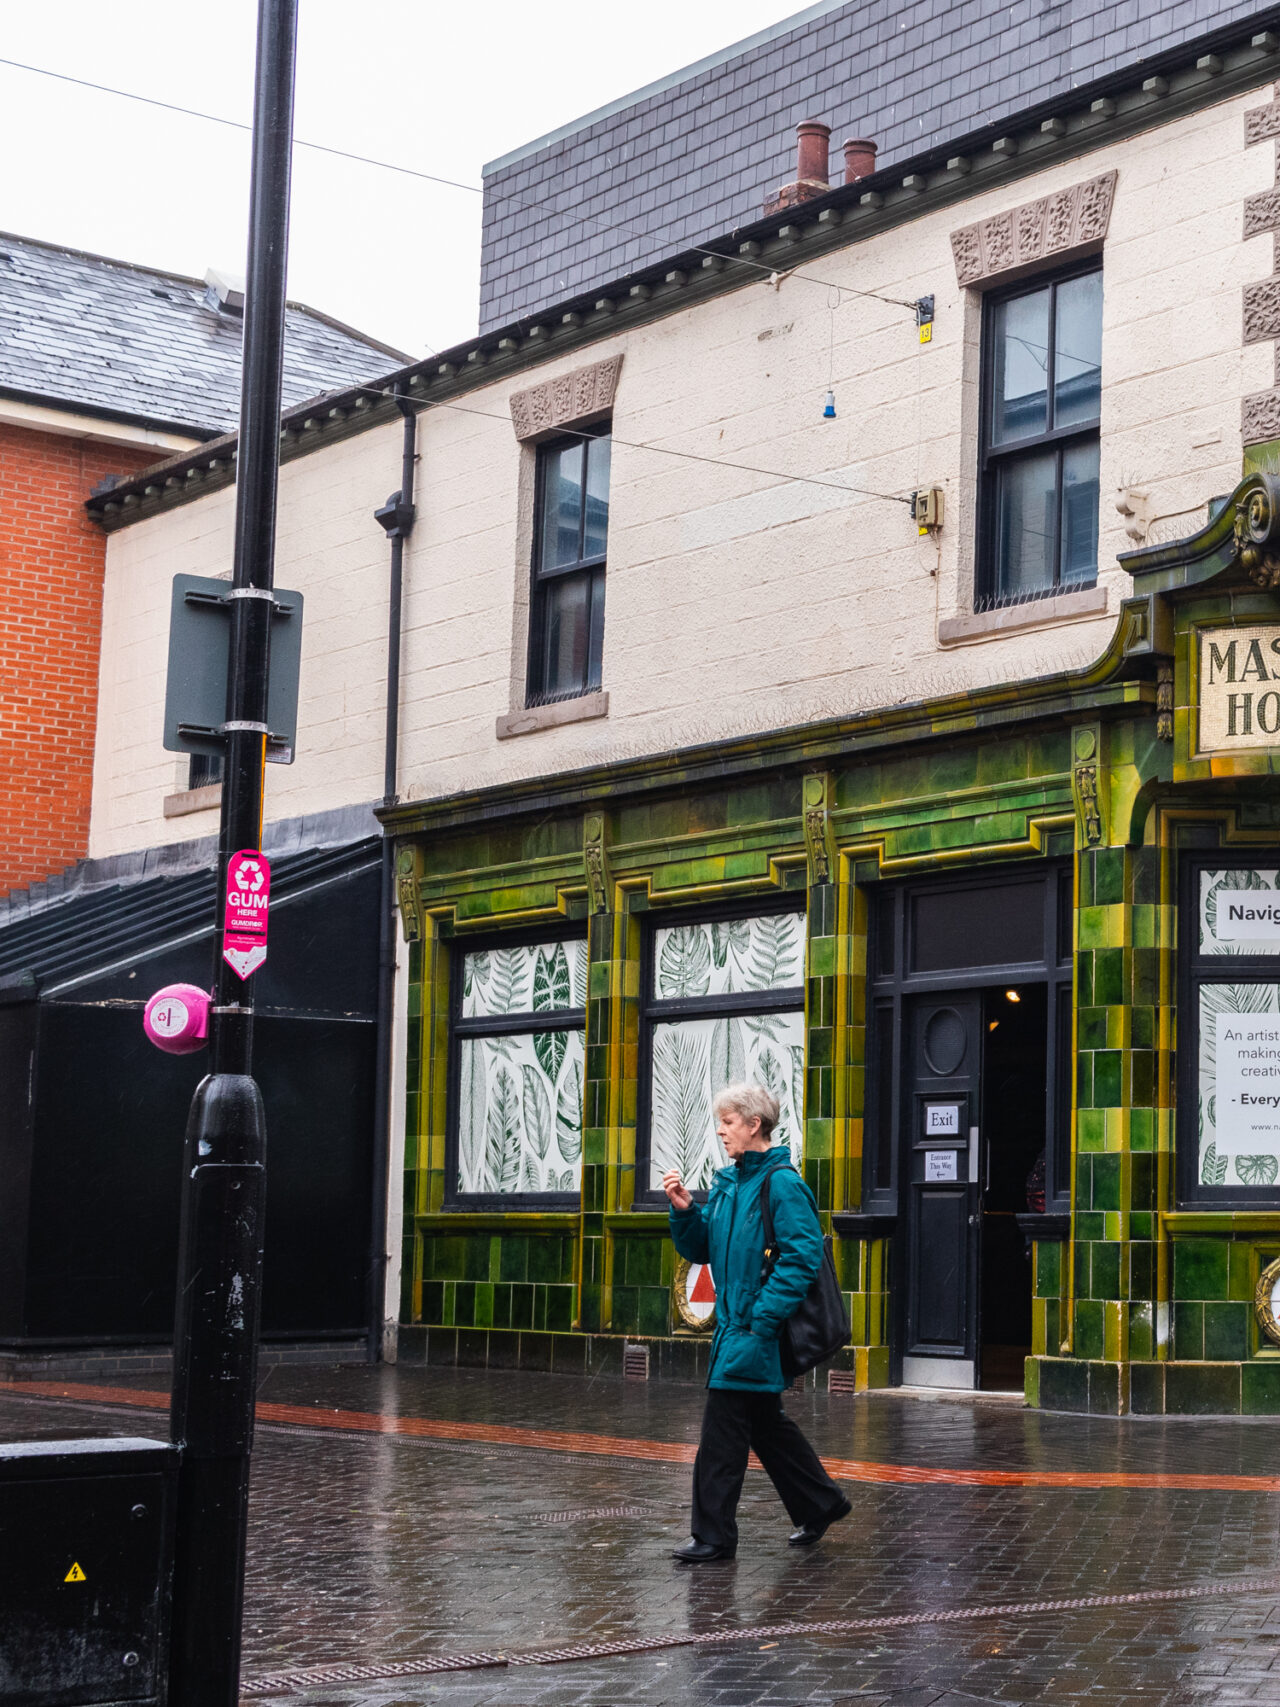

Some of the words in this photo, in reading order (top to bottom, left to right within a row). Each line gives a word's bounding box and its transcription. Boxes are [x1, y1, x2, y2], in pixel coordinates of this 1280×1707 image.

[228, 892, 268, 909] GUM
[237, 909, 258, 917] HERE
[1224, 1029, 1242, 1041] An
[1247, 1029, 1279, 1041] artist
[931, 1112, 953, 1127] Exit
[930, 1162, 940, 1170] This
